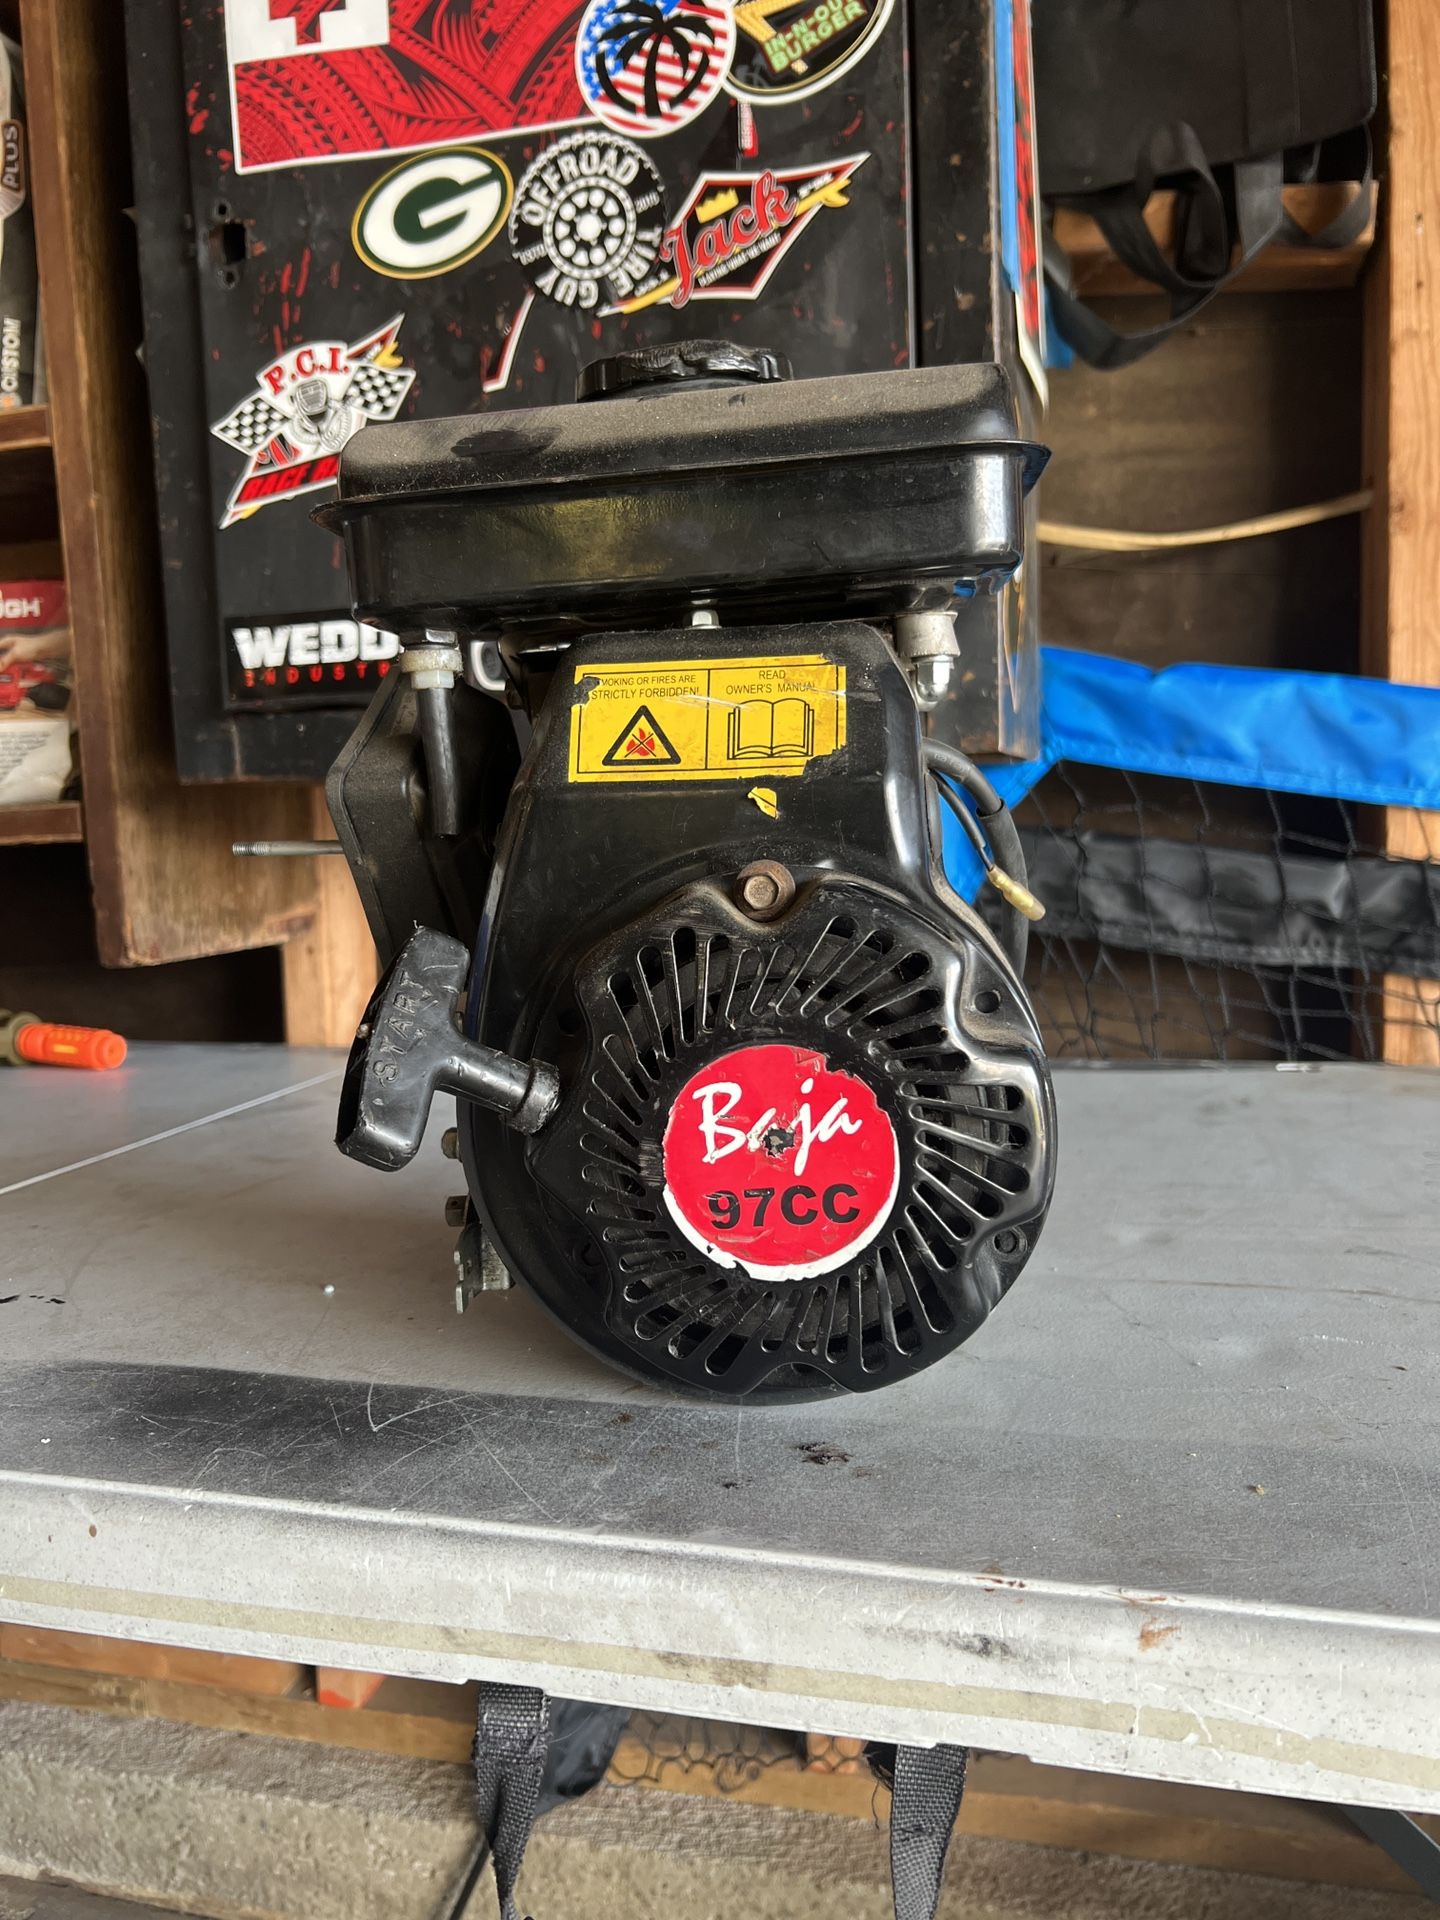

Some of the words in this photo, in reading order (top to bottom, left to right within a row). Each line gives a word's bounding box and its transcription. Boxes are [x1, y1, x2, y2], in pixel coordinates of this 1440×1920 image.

[764, 0, 854, 56] IN-N-OU
[770, 0, 868, 72] BURGER
[2, 125, 20, 189] PLUS
[521, 147, 639, 226] OFFROAD
[609, 226, 662, 297] TIRE
[659, 168, 799, 309] Jack
[535, 266, 599, 309] GUY
[1, 317, 22, 392] CUSTOM
[591, 688, 637, 700] STRICTLY
[600, 677, 635, 687] MOKING
[636, 676, 650, 686] OR
[651, 675, 677, 684] FIRES
[678, 674, 697, 683] ARE
[725, 683, 773, 695] OWNER'S
[758, 669, 786, 680] READ
[372, 969, 425, 1082] START
[692, 1077, 863, 1177] Baja
[707, 1183, 861, 1230] 97CC
